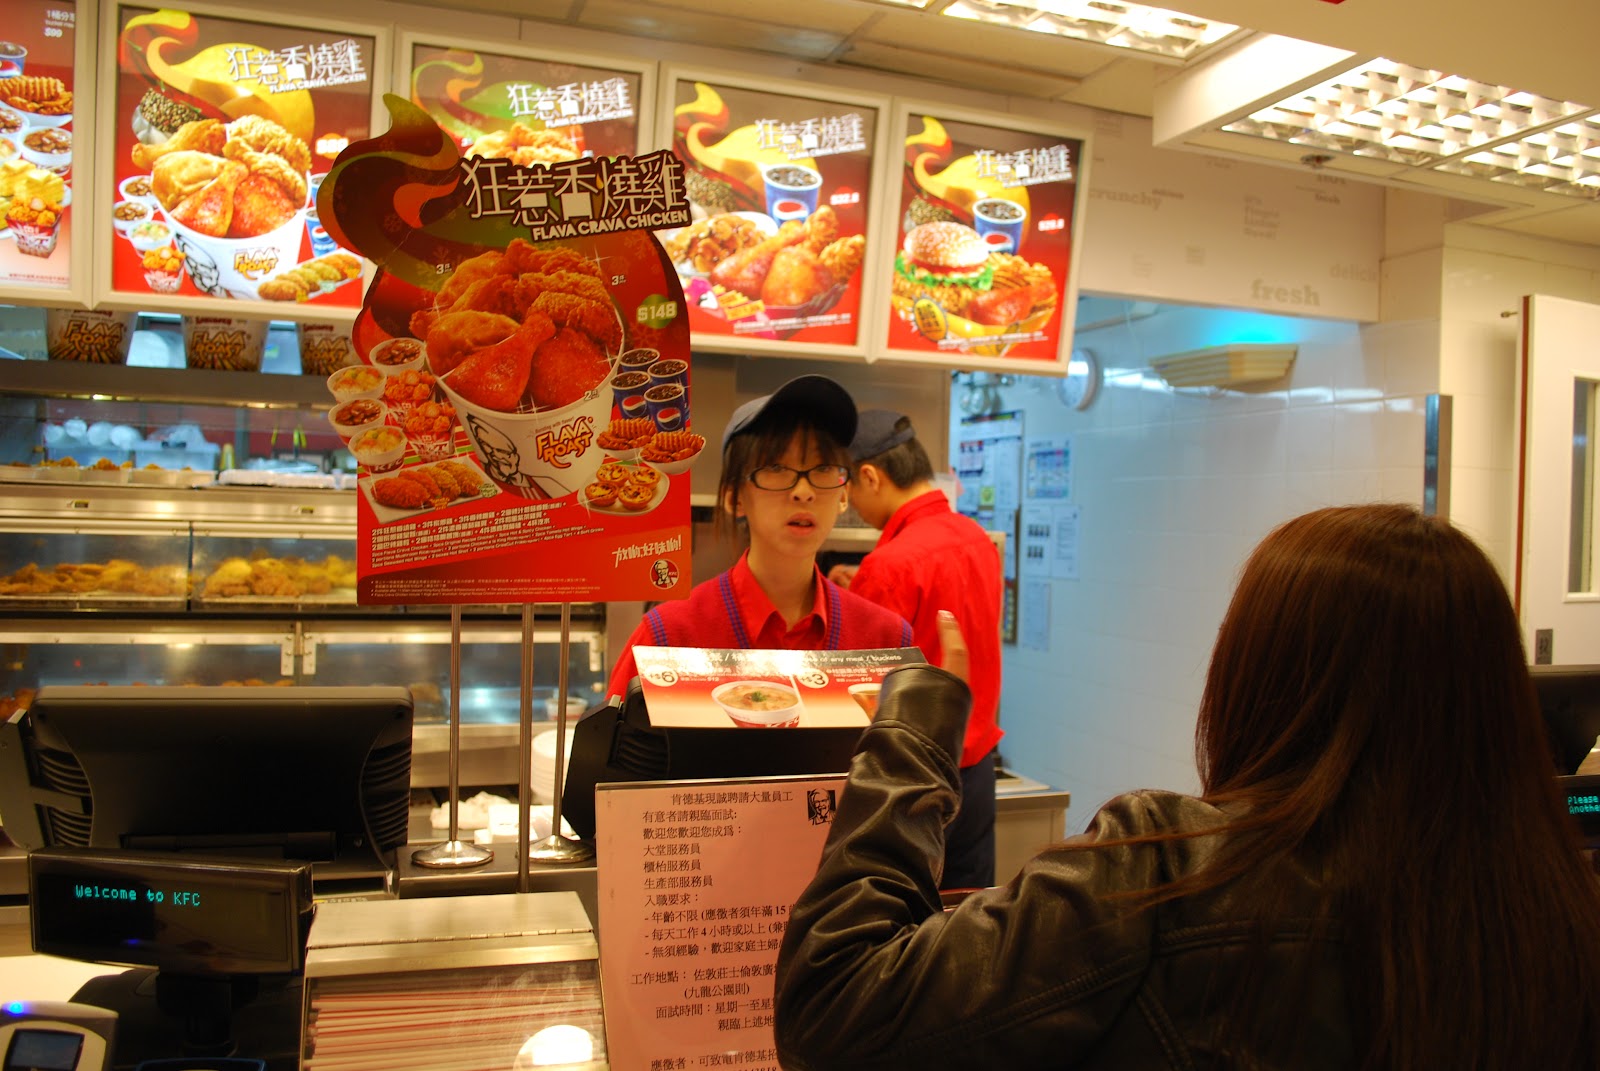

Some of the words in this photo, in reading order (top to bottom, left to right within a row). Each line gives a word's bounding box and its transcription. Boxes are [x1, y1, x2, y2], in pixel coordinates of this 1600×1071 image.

[270, 82, 296, 94] FLAVA
[297, 79, 326, 90] CRAVA
[327, 72, 367, 87] CHICKEN
[460, 153, 686, 226] 狂惹香燒雞
[533, 226, 576, 241] FLAVA
[577, 219, 626, 236] CRAVA
[627, 209, 688, 228] CHICKEN
[233, 247, 280, 272] FLAVA
[1251, 278, 1321, 306] fresh
[637, 301, 677, 321] $148
[64, 320, 124, 340] FLAVA
[191, 331, 246, 350] FLAVA
[536, 416, 592, 460] FLAVA
[543, 433, 593, 468] ROAST
[671, 791, 794, 806] 肯德基現誠聘請大量員工
[1568, 796, 1599, 805] Please
[1569, 804, 1600, 815] anothe
[643, 843, 700, 857] 大堂服務員
[644, 875, 713, 890] 生產部服務員
[75, 885, 137, 900] Welcome
[147, 889, 164, 902] to
[173, 892, 200, 906] KFC
[652, 909, 698, 924] 年齡不限
[776, 905, 786, 915] 15
[652, 927, 698, 941] 每天工作
[701, 928, 707, 936] 4
[709, 923, 766, 938] 小時或以上
[656, 997, 775, 1019] 面試時間：星期一至星
